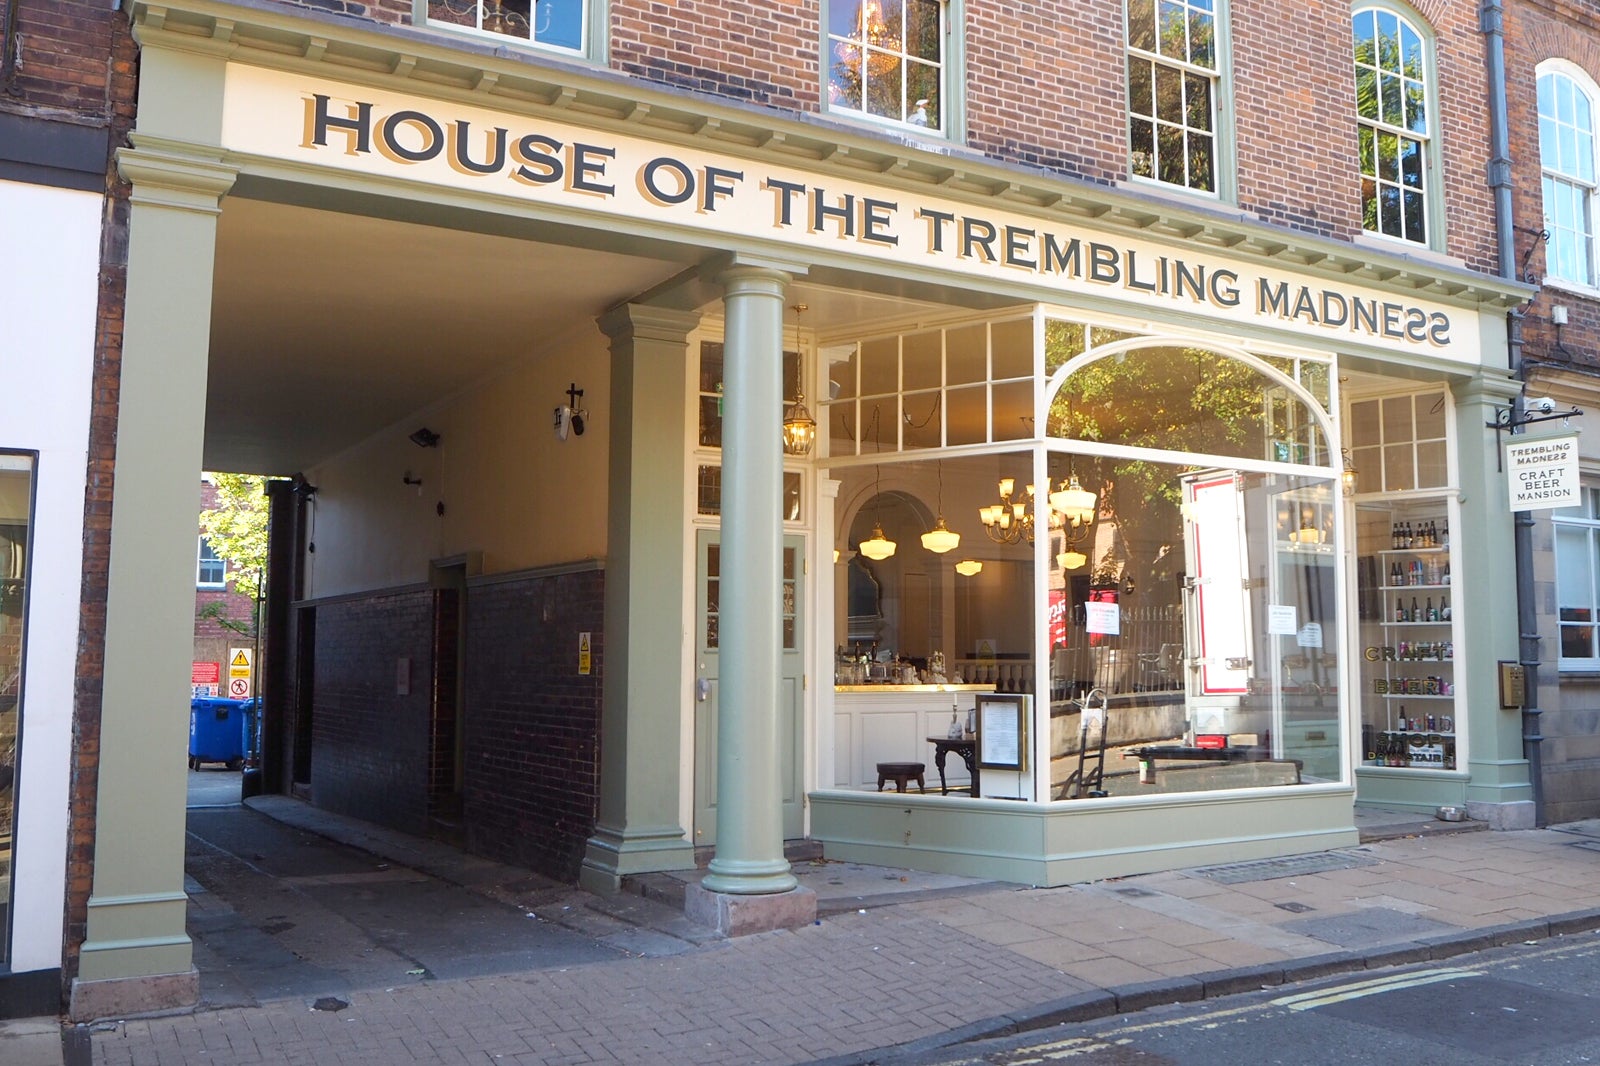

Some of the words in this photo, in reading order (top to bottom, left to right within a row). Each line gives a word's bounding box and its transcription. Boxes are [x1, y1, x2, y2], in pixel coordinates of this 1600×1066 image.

[304, 94, 616, 198] HOUSE
[638, 156, 743, 213] OF
[763, 176, 899, 246] THE
[919, 207, 1241, 307] TREMBLING
[1257, 276, 1451, 347] MADNESS
[1511, 443, 1570, 456] TREMBLING
[1517, 453, 1566, 465] MADNESS
[1519, 468, 1564, 481] CRAFT
[1525, 479, 1560, 490] BEER
[1518, 489, 1570, 500] MANSION
[1364, 646, 1447, 661] CRAFT
[1374, 678, 1438, 695] BEER
[1377, 732, 1441, 748] SHOP
